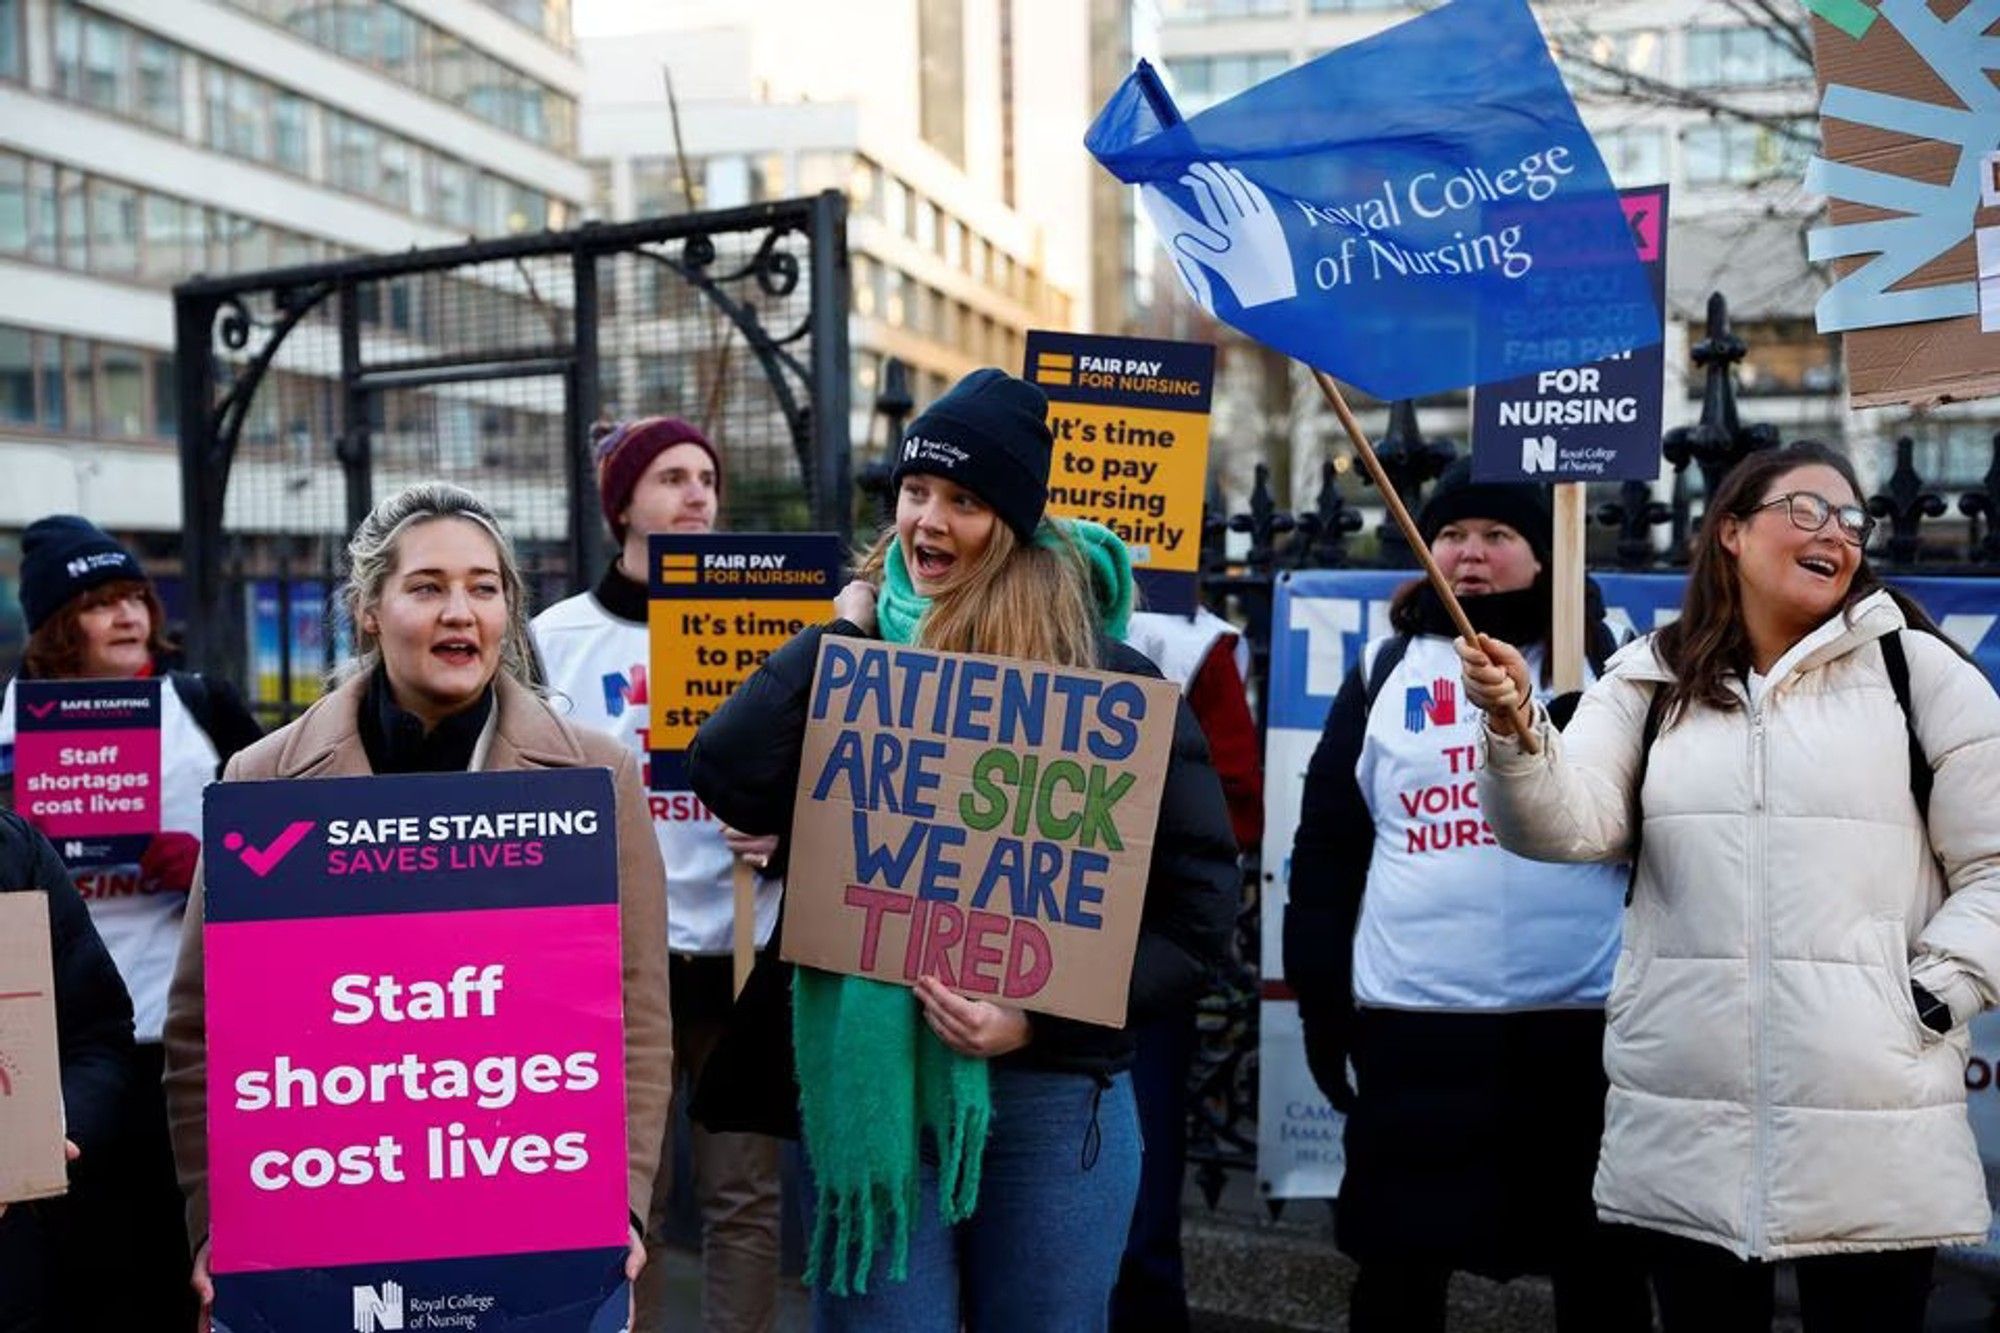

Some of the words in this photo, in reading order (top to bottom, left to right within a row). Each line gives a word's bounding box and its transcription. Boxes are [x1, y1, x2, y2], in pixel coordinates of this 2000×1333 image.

[1409, 146, 1574, 218] College
[1315, 239, 1355, 290] of
[1368, 225, 1533, 278] Nursing
[1080, 356, 1121, 374] FAIR
[1125, 360, 1161, 376] PAY
[1537, 368, 1600, 394] FOR
[1079, 373, 1115, 390] FOR
[1120, 377, 1201, 396] NURSING
[1499, 398, 1638, 426] NURSING
[1052, 417, 1097, 442] It's
[1105, 419, 1176, 449] time
[1063, 451, 1095, 474] to
[1102, 458, 1158, 484] pay
[1048, 485, 1166, 517] nursing
[703, 554, 746, 568] FAIR
[750, 555, 786, 569] PAY
[704, 570, 740, 584] FOR
[745, 570, 826, 584] NURSING
[682, 614, 727, 635] It's
[735, 612, 804, 635] time
[697, 648, 727, 666] to
[736, 651, 770, 672] pa
[812, 643, 1148, 761] PATIENTS
[60, 746, 118, 766] Staff
[27, 772, 149, 792] shortages
[812, 729, 947, 819] ARE
[958, 747, 1137, 851] SICK
[32, 797, 83, 815] cost
[90, 796, 144, 812] lives
[1399, 782, 1479, 818] VOIC
[327, 819, 420, 845] SAFE
[428, 810, 598, 841] STAFFING
[327, 846, 439, 875] SAVES
[450, 841, 544, 869] LIVES
[851, 809, 967, 903] WE
[970, 837, 1110, 930] ARE
[844, 884, 1054, 999] TIRED
[331, 964, 505, 1025] Staff
[234, 1051, 600, 1112] shortages
[249, 1135, 405, 1192] cost
[427, 1122, 590, 1181] lives
[410, 1296, 445, 1313] Royal
[448, 1294, 495, 1312] College
[410, 1315, 424, 1328] of
[427, 1313, 476, 1330] Nursing
